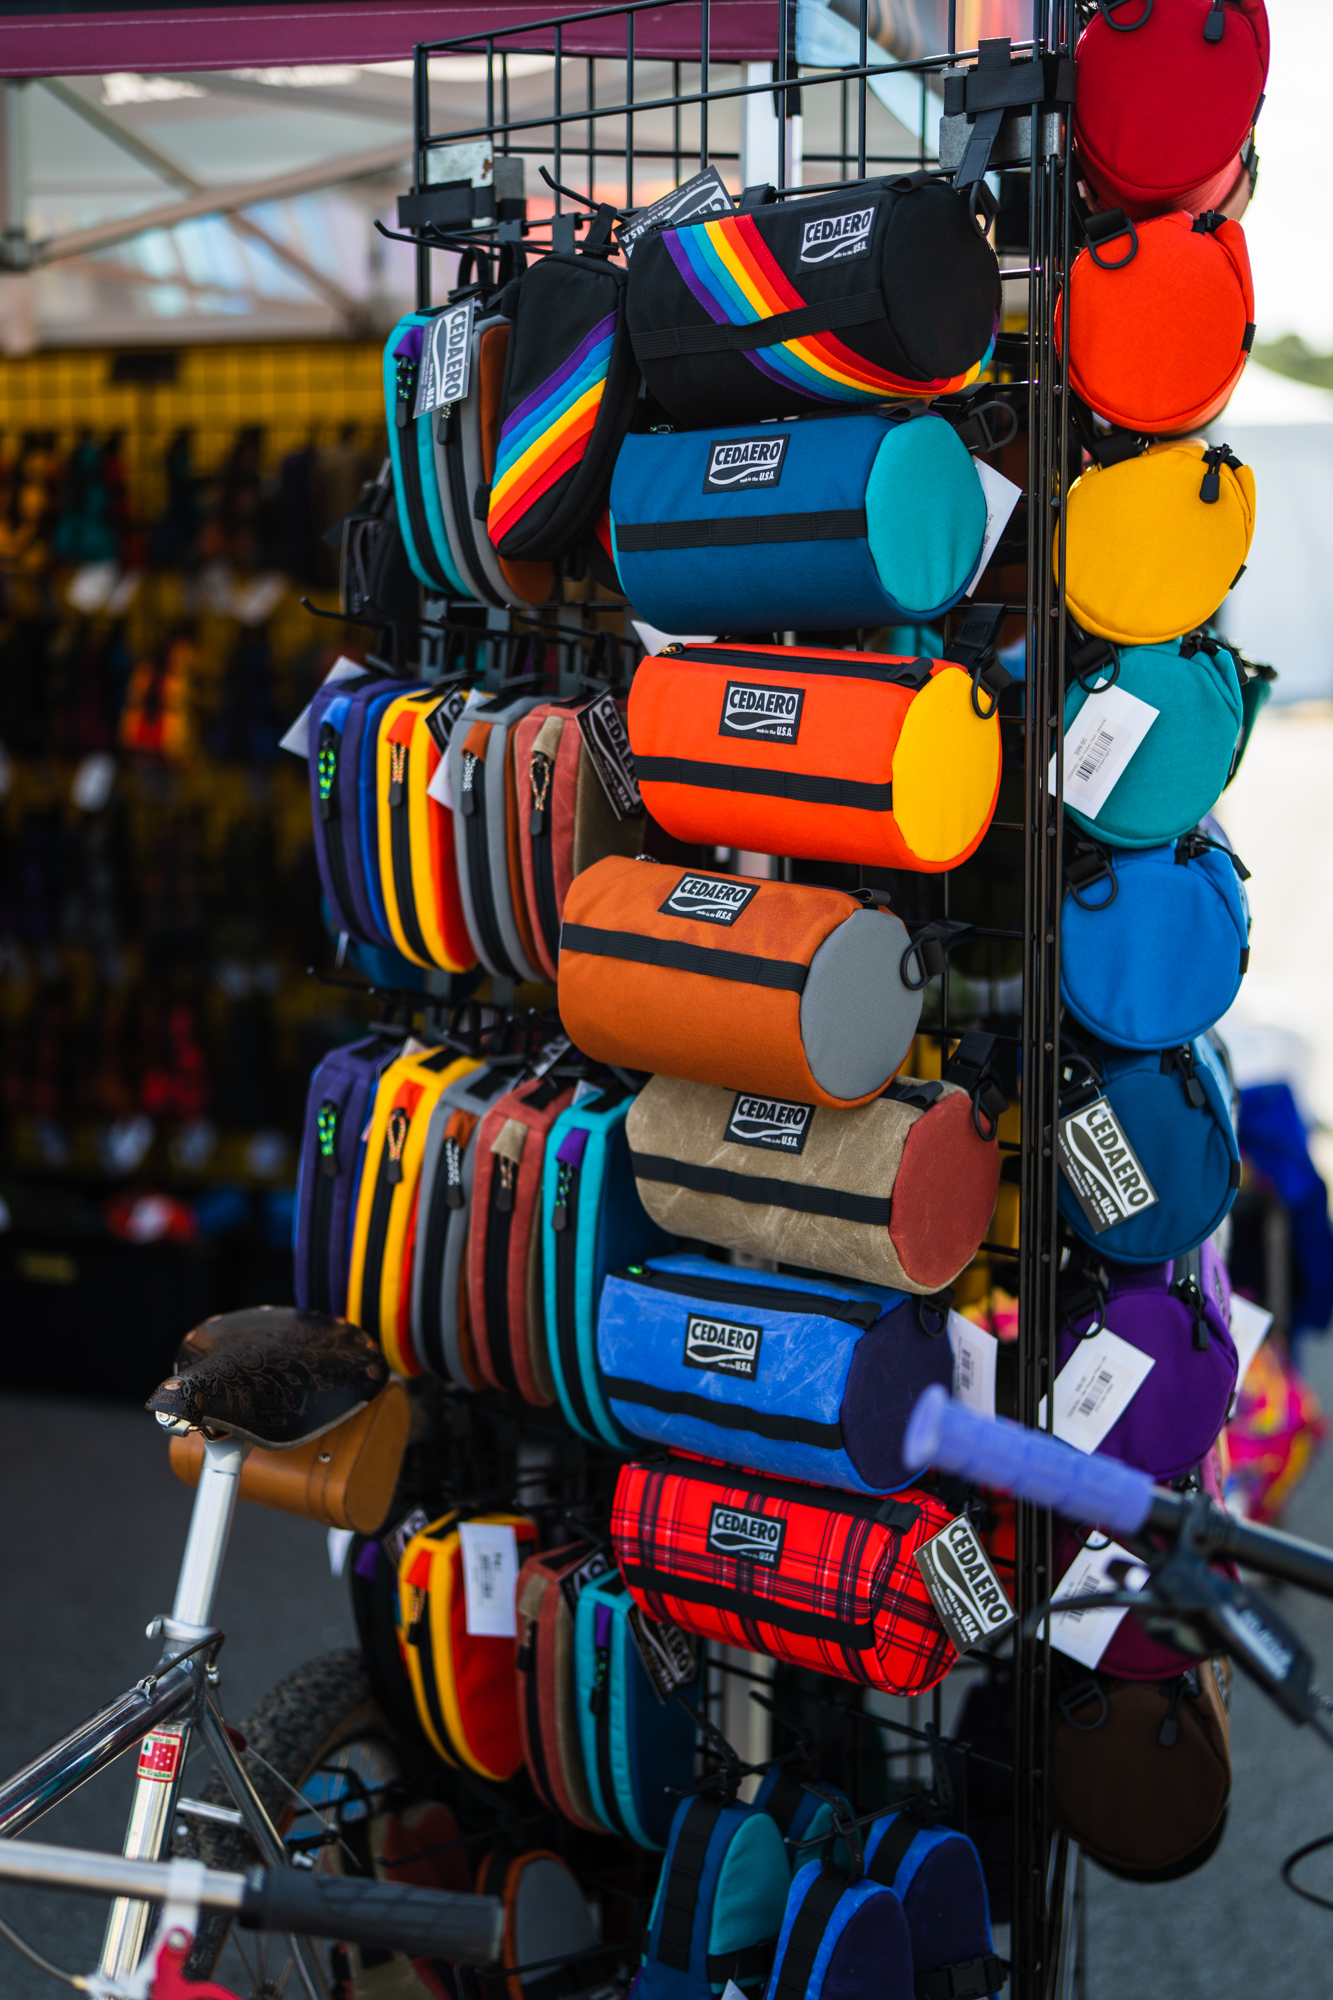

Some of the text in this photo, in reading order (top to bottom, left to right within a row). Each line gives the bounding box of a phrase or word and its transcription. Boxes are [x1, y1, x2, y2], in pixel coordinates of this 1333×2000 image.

[620, 225, 645, 244] U.S.A.
[805, 210, 871, 243] CEDAERO
[443, 310, 467, 400] CEDAERO
[715, 442, 781, 466] CEDAERO
[759, 471, 774, 481] U.S.A.
[730, 689, 796, 715] CEDAERO
[776, 726, 793, 737] U.S.A.
[680, 880, 747, 902] CEDAERO
[738, 1099, 806, 1125] CEDAERO
[1086, 1109, 1148, 1207] CEDAERO
[1100, 1196, 1119, 1225] U.S.A.
[691, 1322, 755, 1351] CEDAERO
[715, 1512, 778, 1542] CEDAERO
[949, 1524, 1008, 1623] CEDAERO
[961, 1614, 980, 1643] U.S.A.
